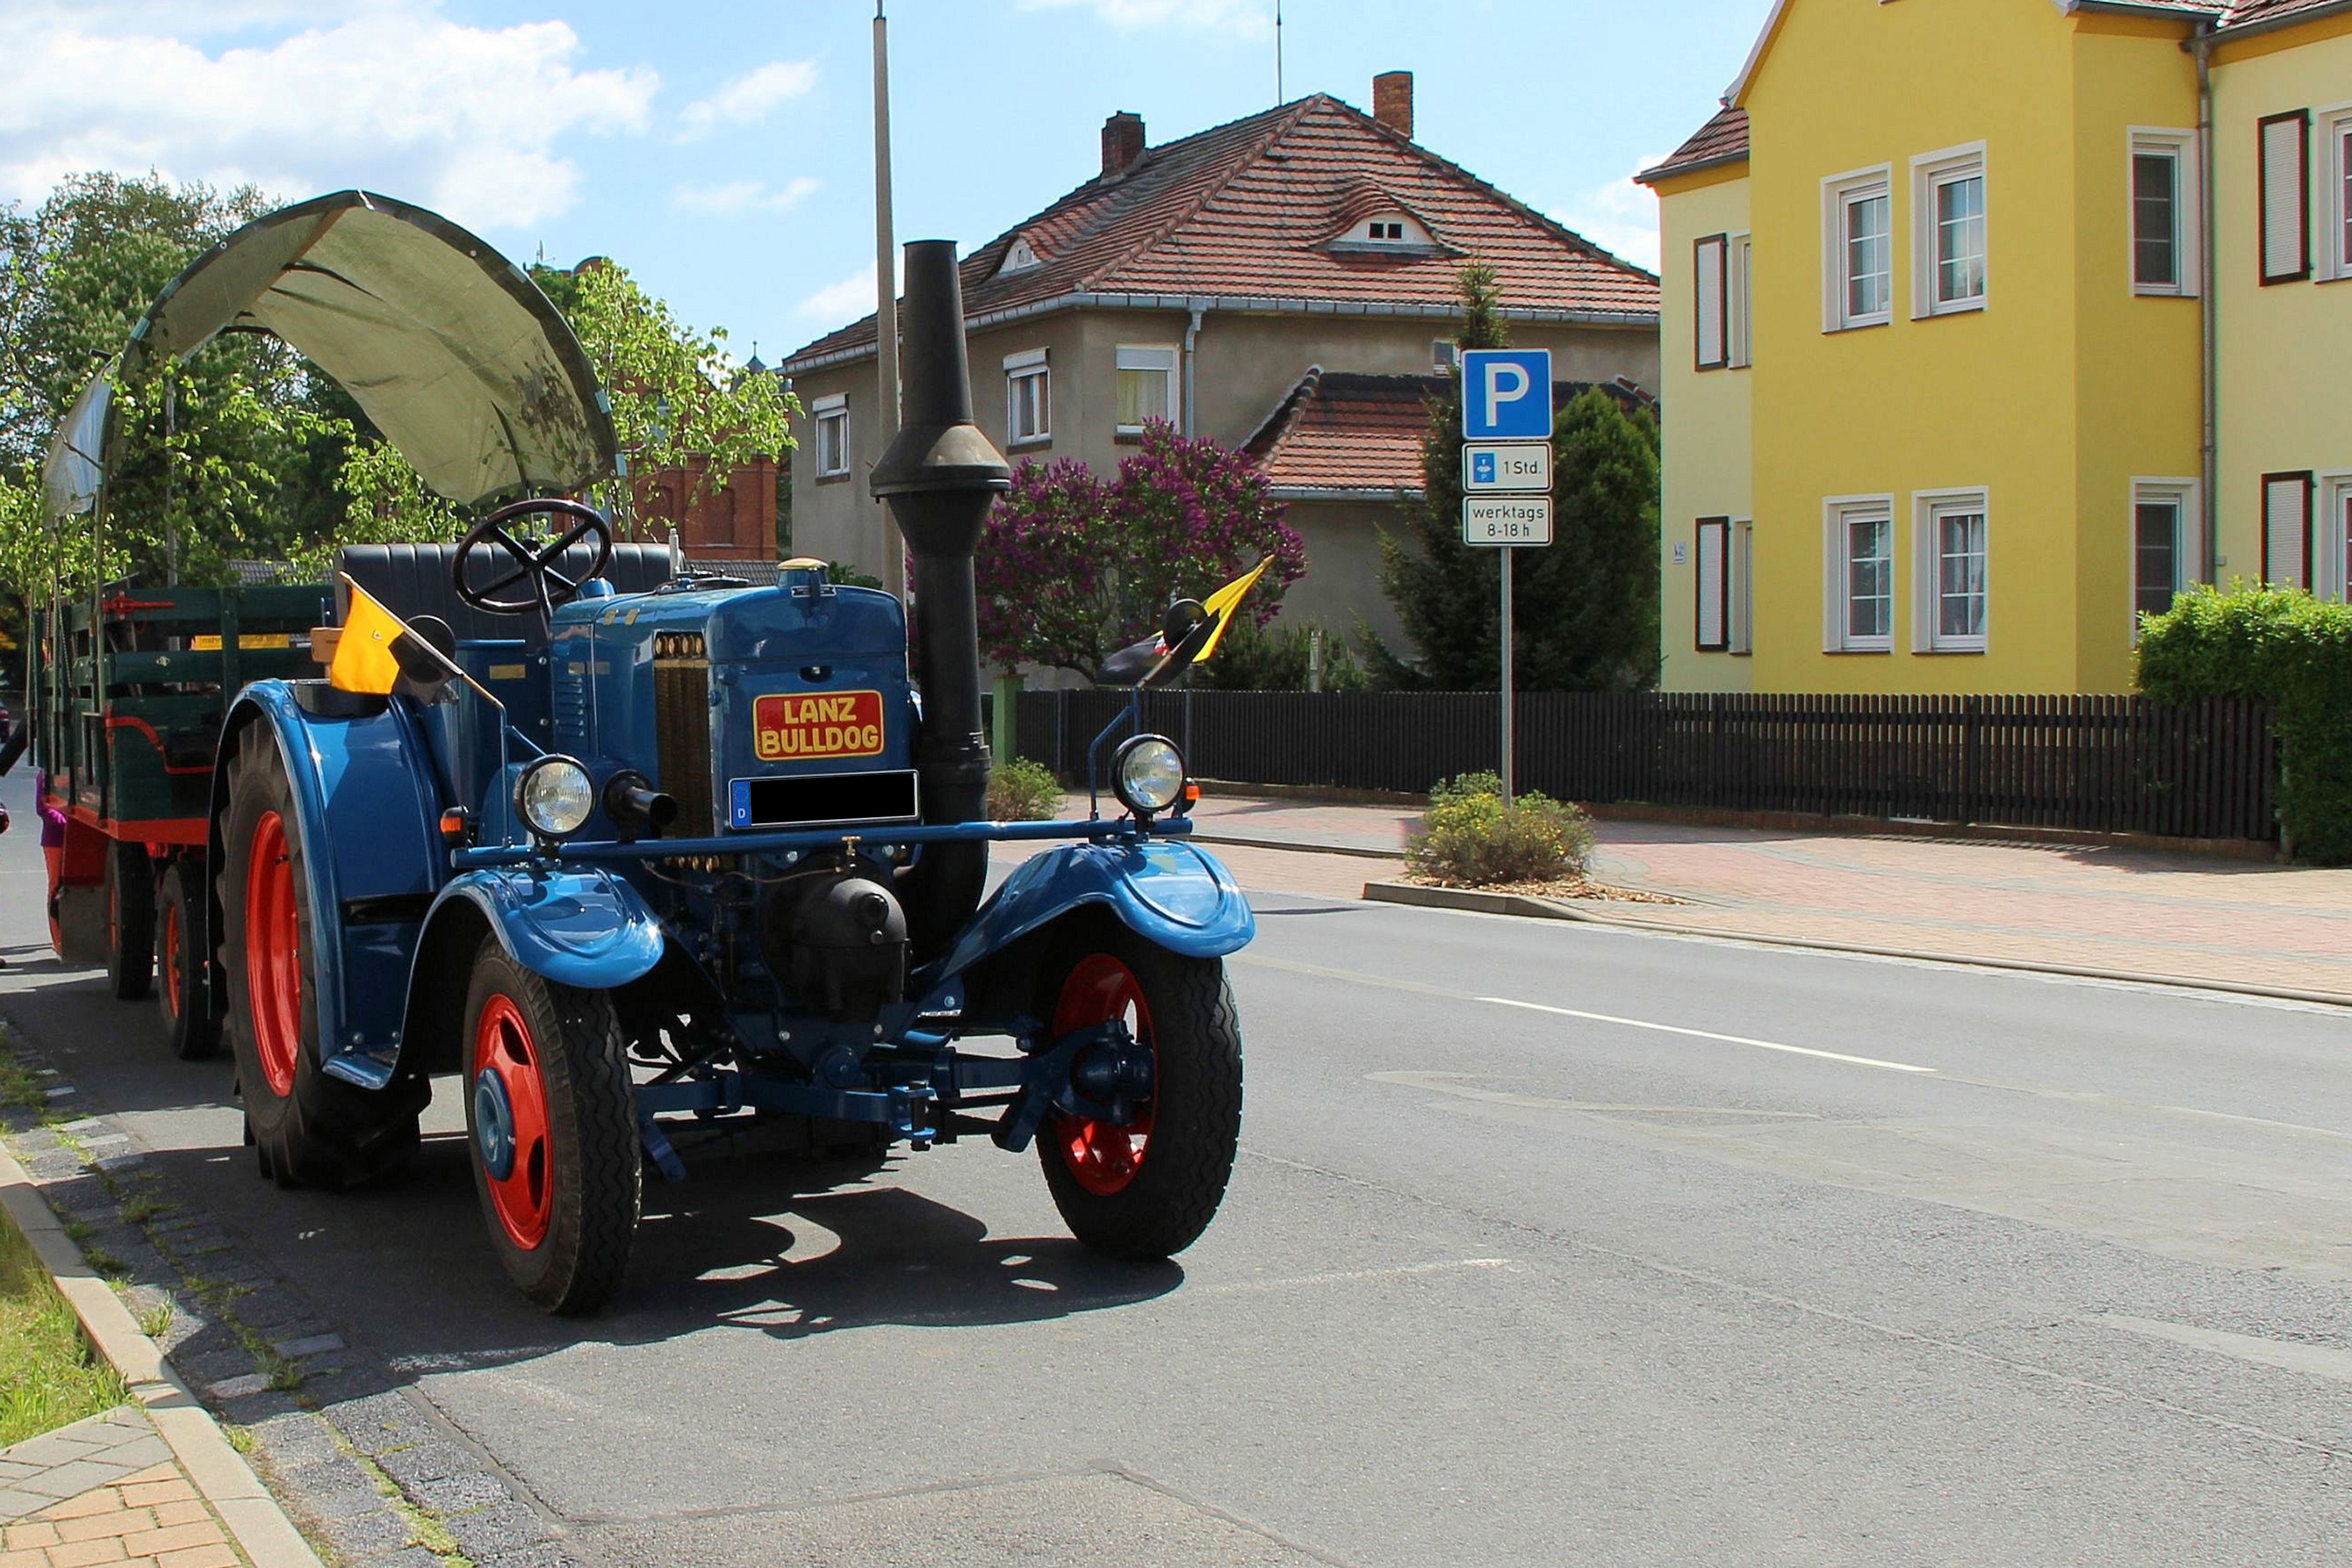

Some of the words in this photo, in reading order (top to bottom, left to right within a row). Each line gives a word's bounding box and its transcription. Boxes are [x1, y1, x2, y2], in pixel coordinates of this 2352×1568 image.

[1484, 362, 1529, 427] P
[1504, 461, 1509, 474] 1
[1513, 461, 1541, 474] Std.
[1472, 506, 1544, 521] werktags
[1487, 523, 1518, 536] 8-18
[1522, 523, 1529, 536] h
[783, 697, 857, 724] LANZ
[761, 724, 879, 754] BULLDOG
[737, 808, 745, 819] D
